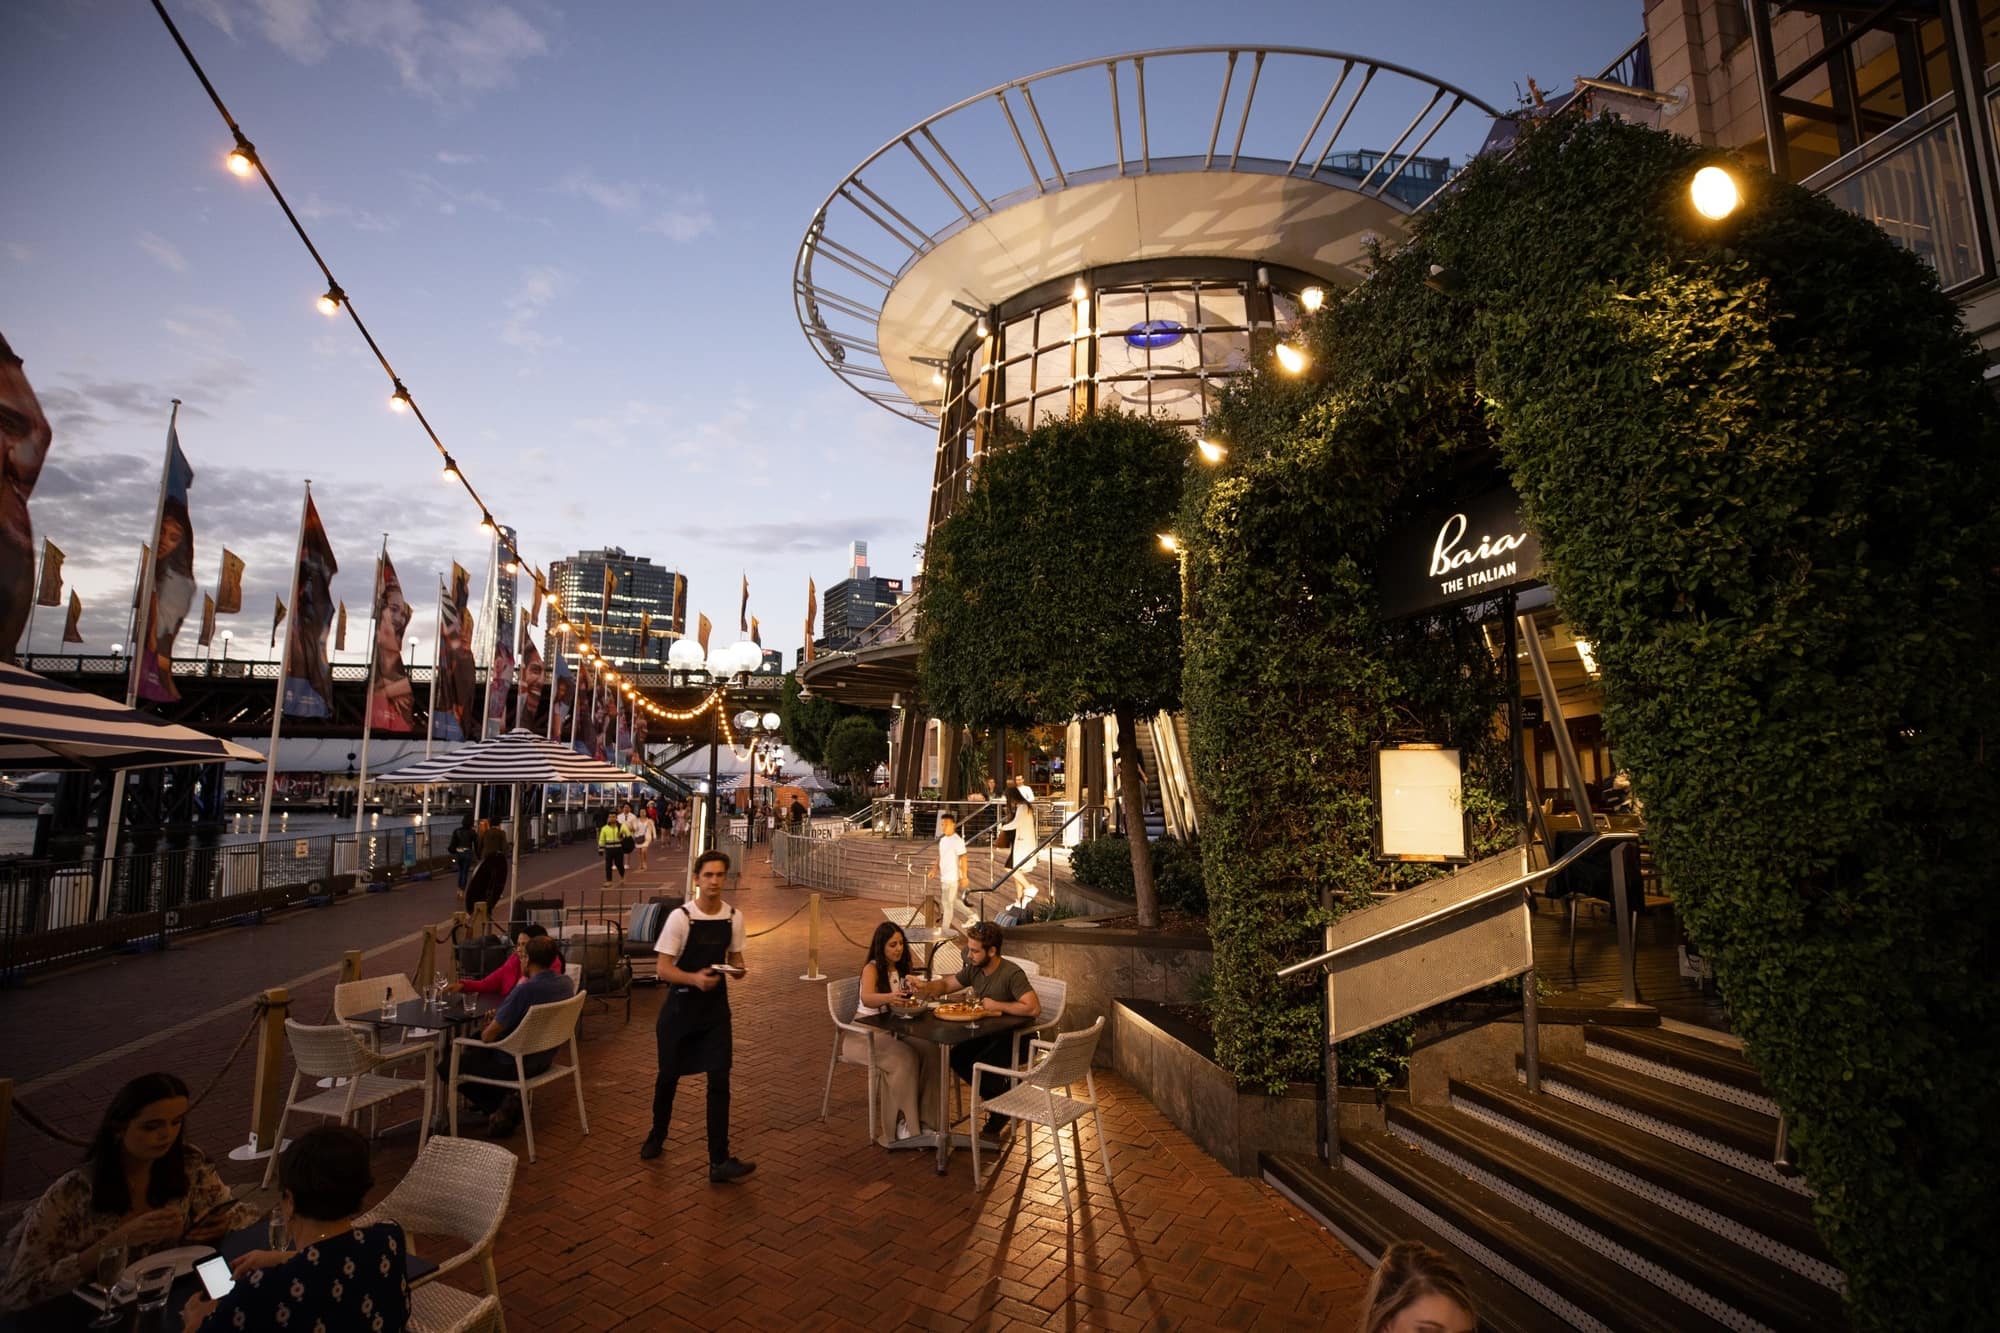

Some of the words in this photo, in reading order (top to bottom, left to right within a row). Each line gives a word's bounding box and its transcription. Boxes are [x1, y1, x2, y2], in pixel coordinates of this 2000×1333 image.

[1429, 513, 1527, 577] Baia
[1441, 578, 1464, 595] THE
[1467, 561, 1517, 588] ITALIAN
[811, 829, 832, 840] OPEN
